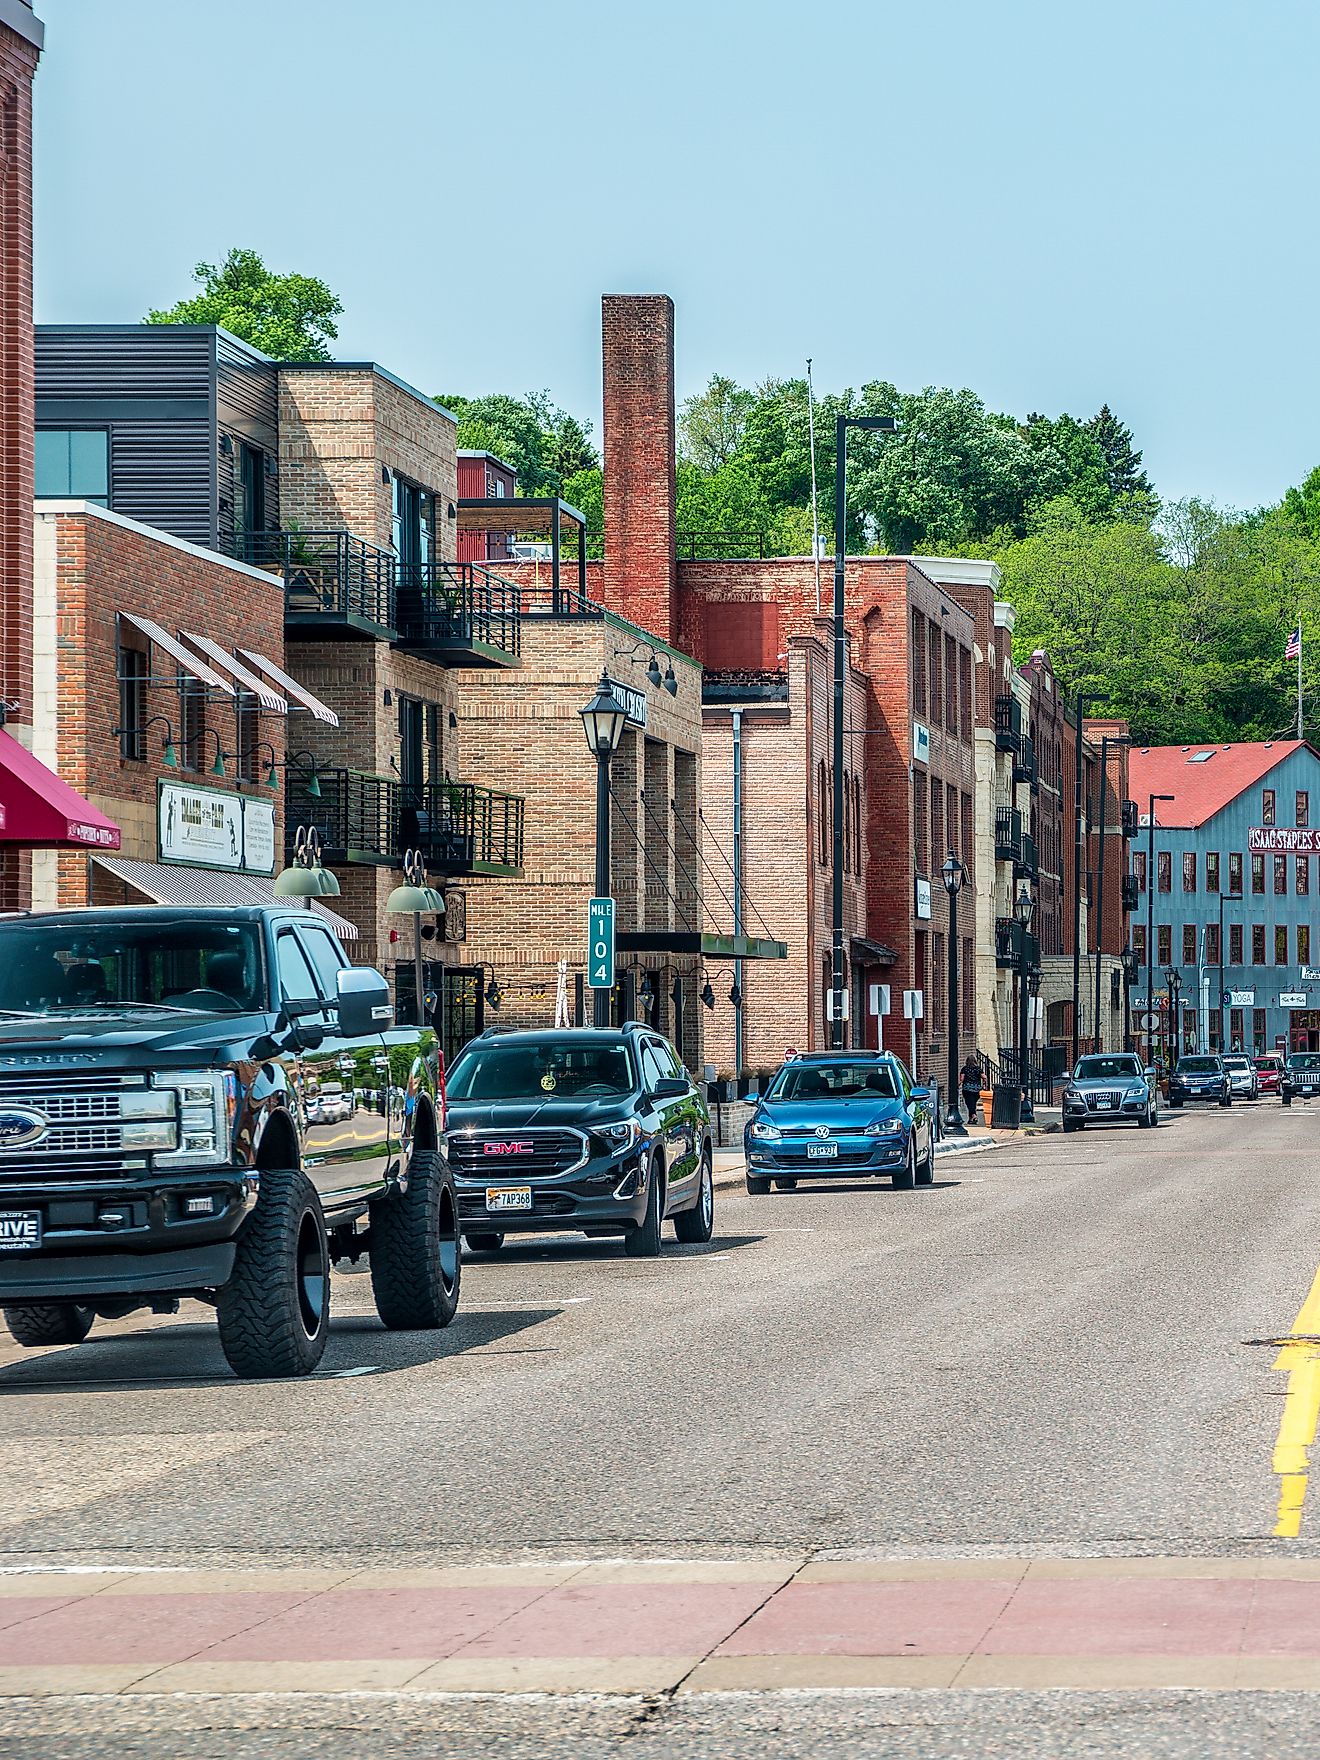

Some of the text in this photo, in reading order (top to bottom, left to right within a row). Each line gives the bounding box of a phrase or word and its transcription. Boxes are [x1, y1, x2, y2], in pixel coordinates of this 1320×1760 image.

[1251, 829, 1275, 848] ISAAC
[1276, 830, 1313, 850] STAPLES
[591, 904, 612, 916] MILE
[594, 919, 607, 981] 104
[1233, 993, 1251, 1003] YOGA
[483, 1141, 534, 1155] GMC
[501, 1193, 530, 1205] 7AP368
